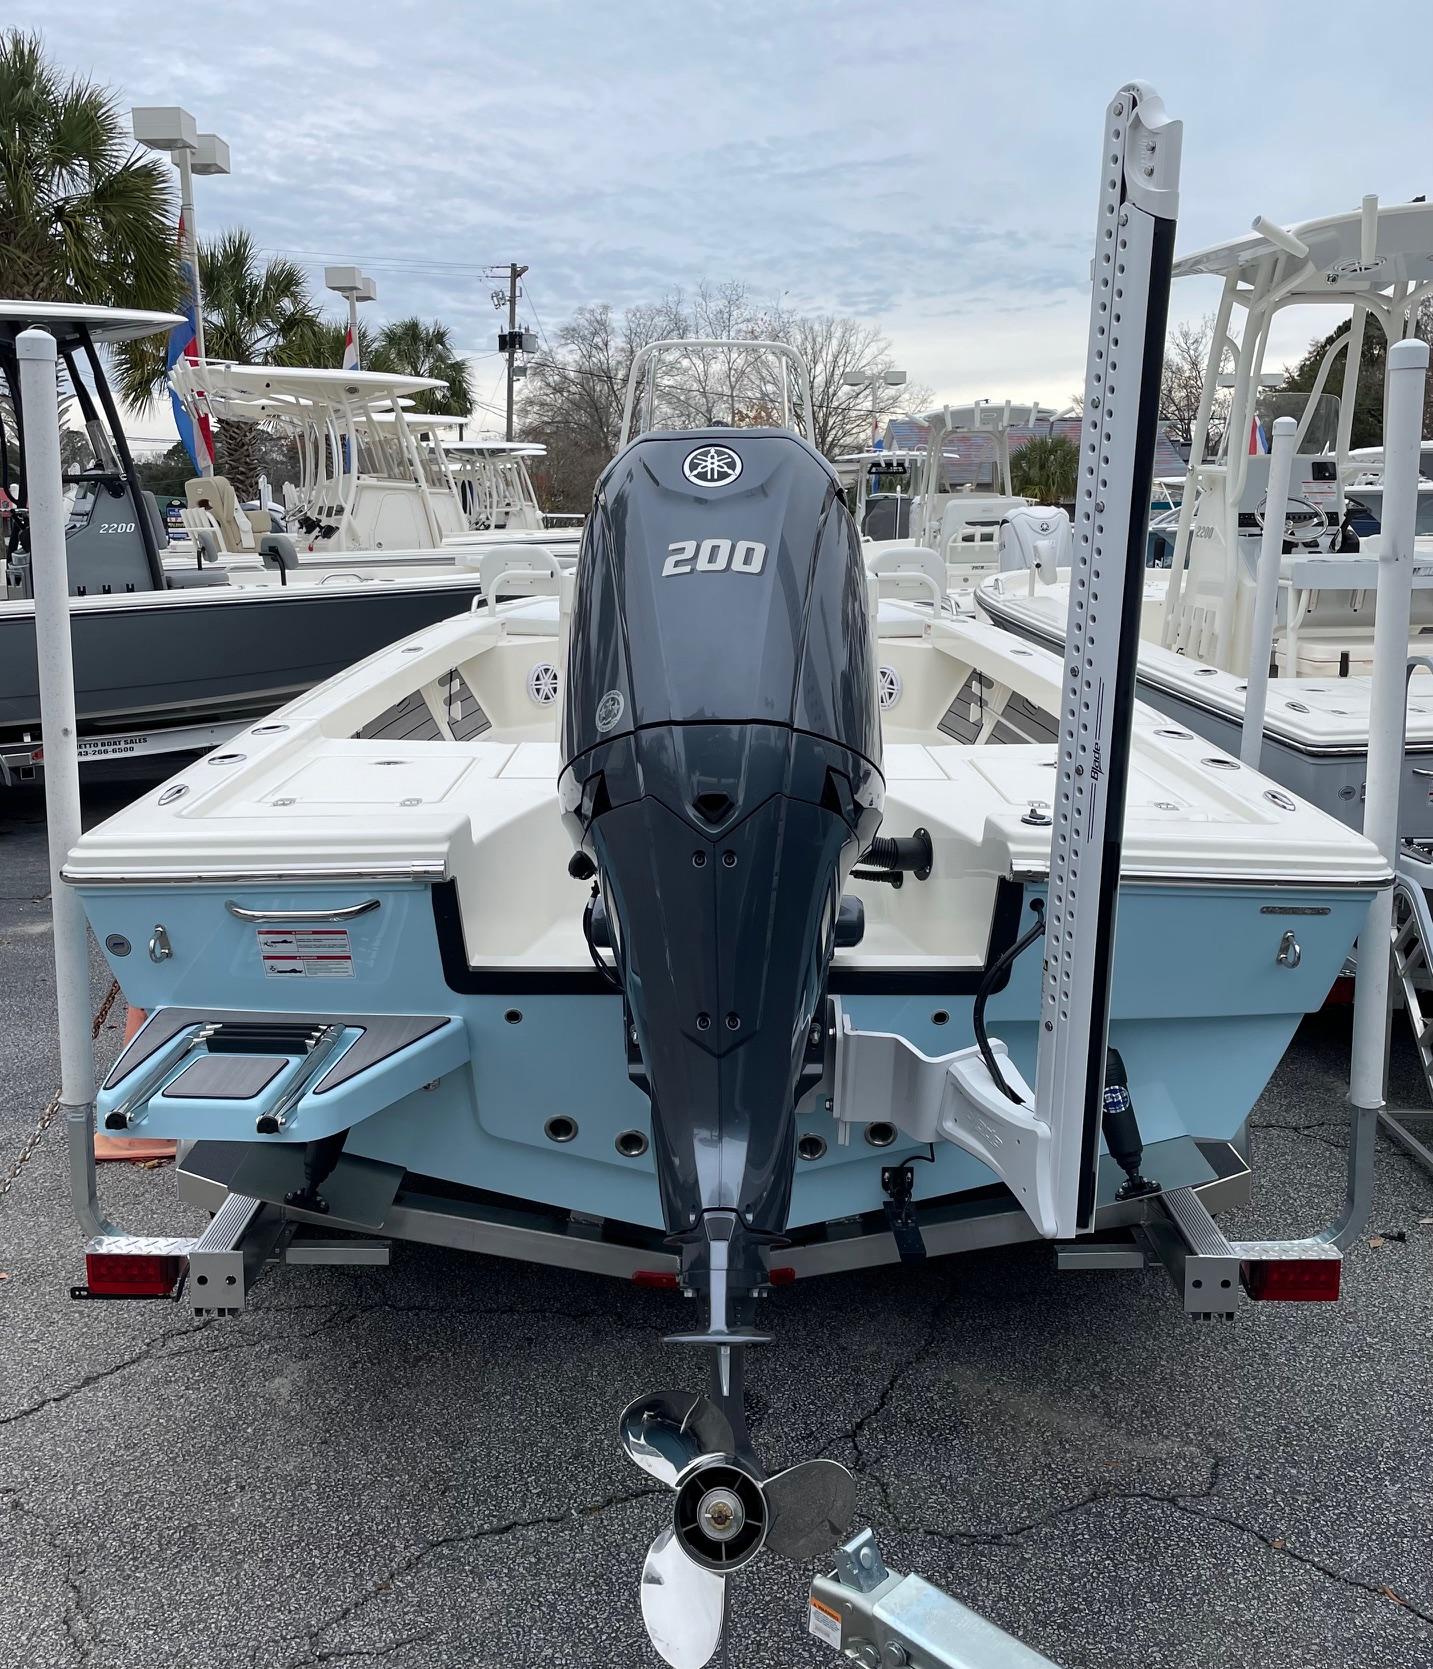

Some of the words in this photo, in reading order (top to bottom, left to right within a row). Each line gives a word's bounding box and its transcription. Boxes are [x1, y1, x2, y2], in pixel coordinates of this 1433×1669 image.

[99, 522, 136, 534] 2200
[661, 538, 769, 577] 200
[1090, 742, 1105, 781] Blade
